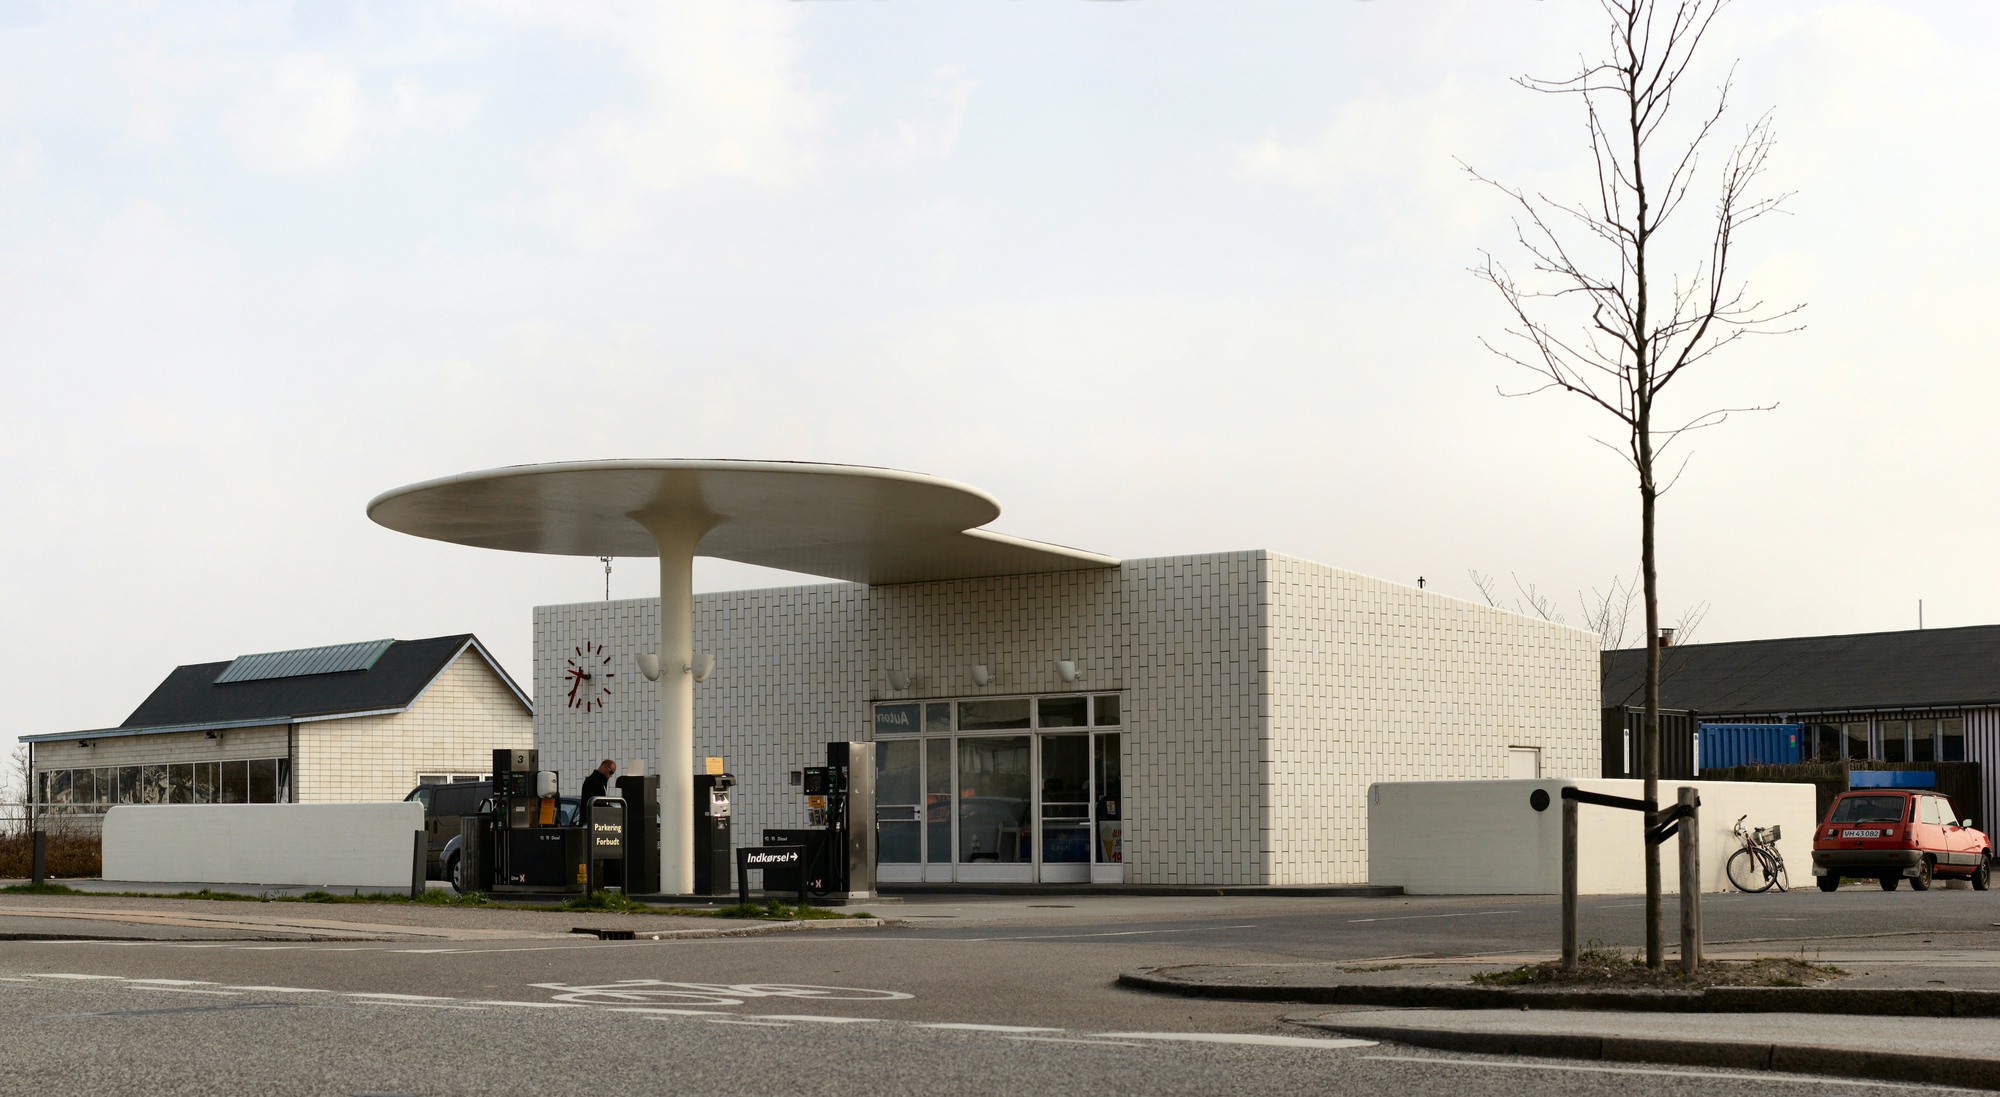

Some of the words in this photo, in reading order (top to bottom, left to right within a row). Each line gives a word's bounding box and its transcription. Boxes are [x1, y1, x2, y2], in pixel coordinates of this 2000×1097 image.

[517, 755, 524, 764] 3
[594, 823, 622, 834] Parkering
[596, 838, 620, 846] Forbudt
[747, 852, 790, 863] Indkørsel
